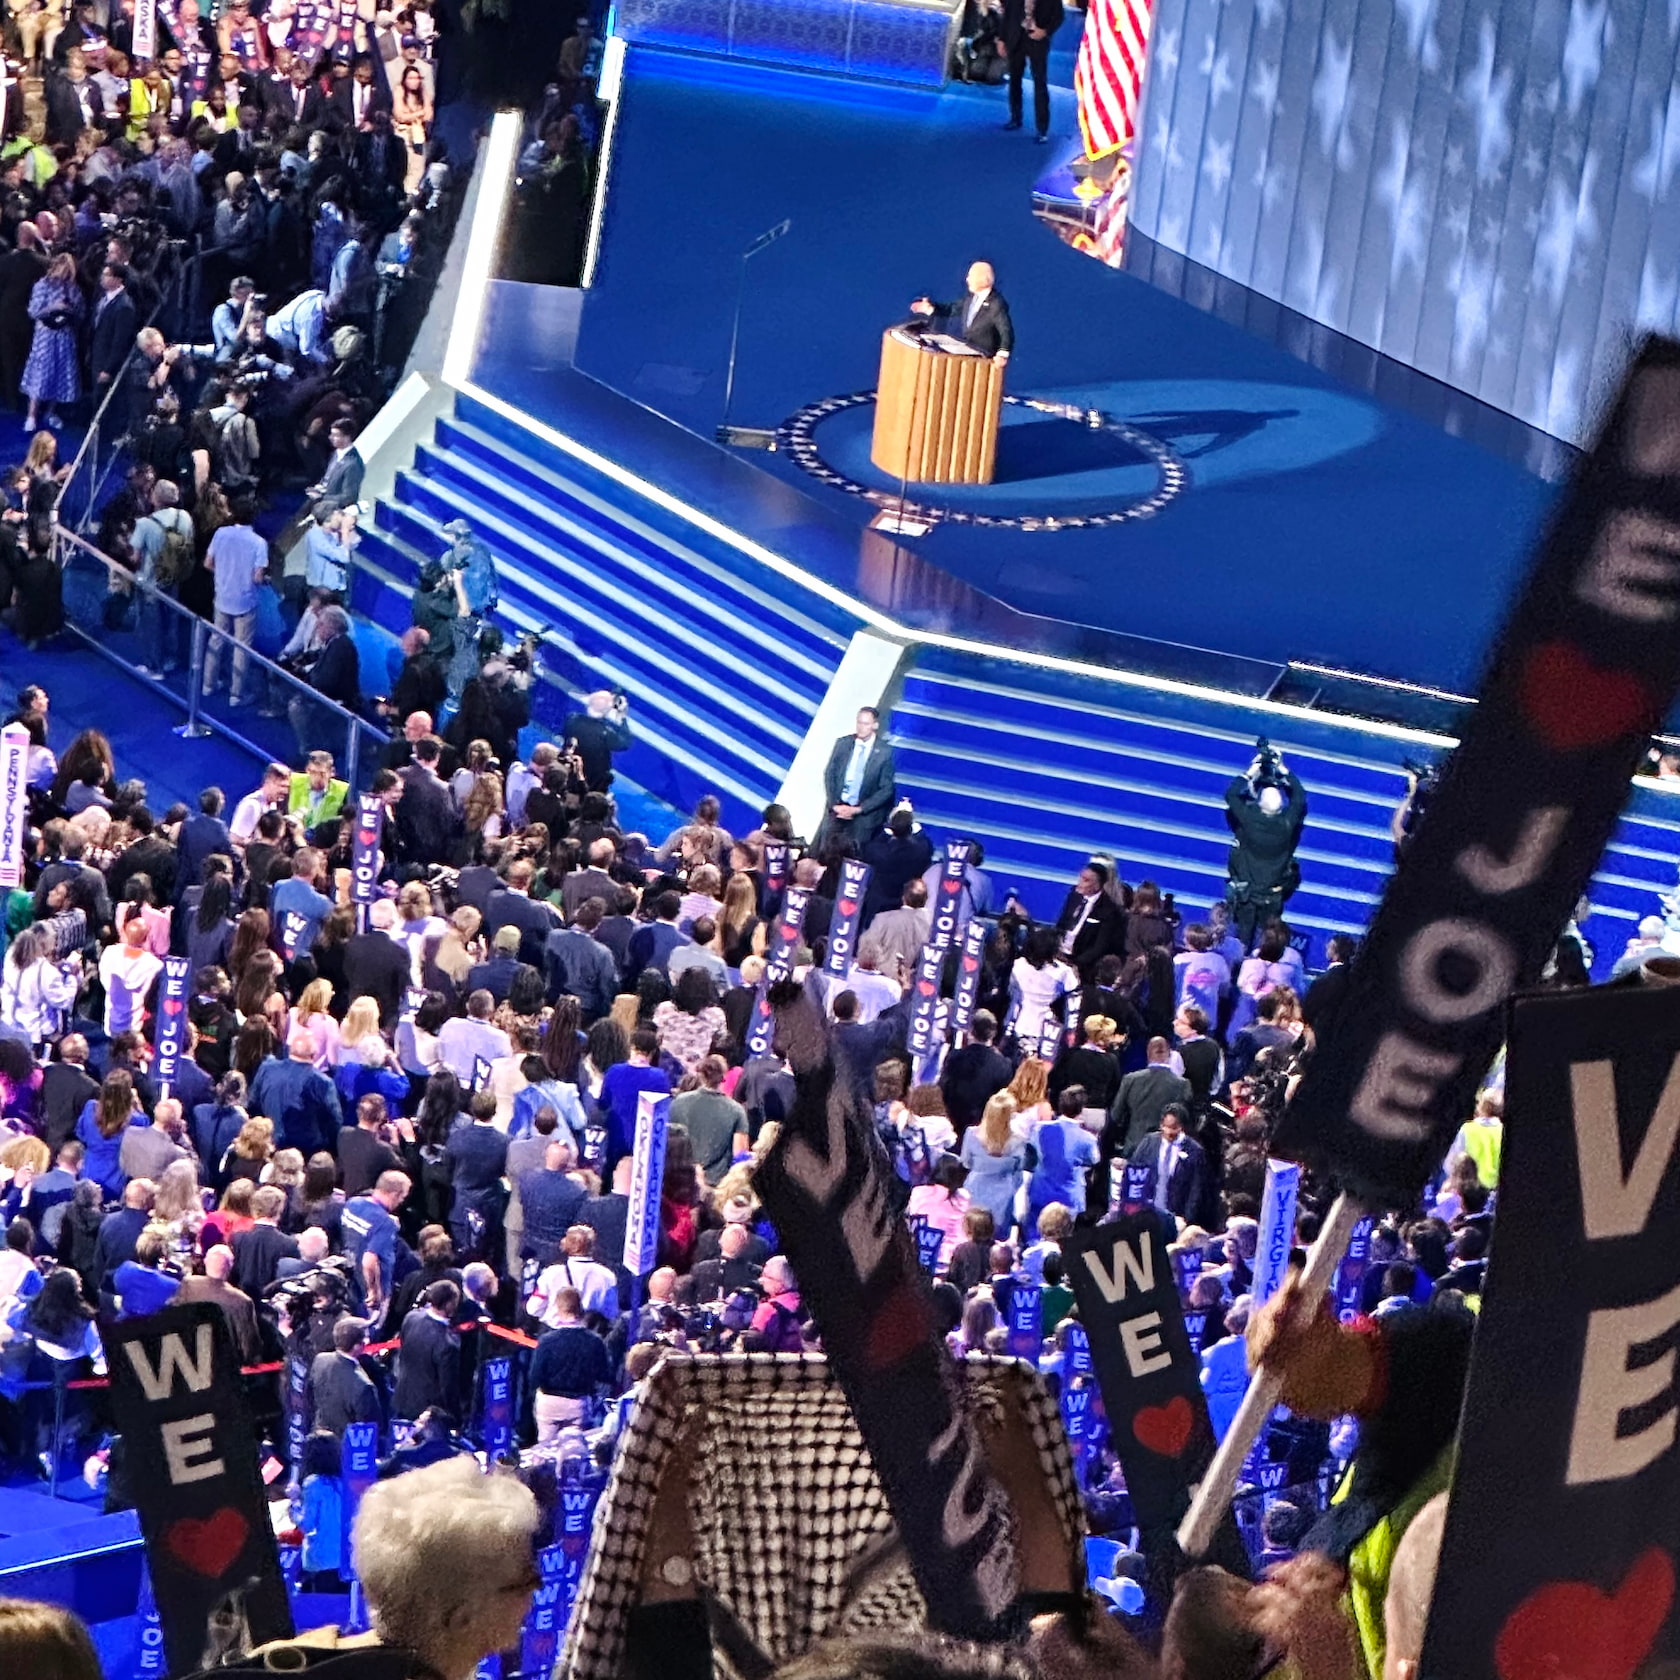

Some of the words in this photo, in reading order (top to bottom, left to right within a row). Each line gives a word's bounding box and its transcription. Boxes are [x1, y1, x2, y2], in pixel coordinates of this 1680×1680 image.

[1, 749, 20, 863] PENNSYLVANIA
[359, 795, 381, 828] WE
[356, 850, 374, 897] JOE
[766, 846, 788, 875] WE
[947, 844, 969, 876] WE
[844, 862, 866, 898] WE
[785, 890, 807, 925] WE
[935, 899, 955, 948] JOE
[283, 911, 307, 946] WE
[829, 922, 850, 971] JOE
[967, 920, 985, 955] WE
[1289, 935, 1307, 951] W
[166, 960, 189, 996] WE
[922, 945, 943, 980] WE
[1350, 805, 1571, 1141] JOE
[955, 976, 973, 1025] JOE
[750, 1021, 770, 1059] JO
[912, 1002, 931, 1049] JOE
[1040, 1021, 1062, 1057] WE
[159, 1021, 178, 1074] JOE
[584, 1128, 607, 1160] WE
[1127, 1167, 1150, 1198] WE
[918, 1229, 942, 1266] WE
[1266, 1189, 1291, 1301] VIRGIN
[1350, 1219, 1373, 1258] WE
[1013, 1290, 1039, 1331] WE
[1083, 1230, 1172, 1379] WE
[1340, 1287, 1358, 1325] JO
[1072, 1329, 1090, 1370] WE
[488, 1360, 510, 1401] WE
[124, 1321, 226, 1487] WE
[1066, 1392, 1089, 1436] WE
[348, 1427, 374, 1471] WE
[489, 1426, 507, 1462] JO
[562, 1493, 591, 1532] WE
[533, 1582, 561, 1630] WE
